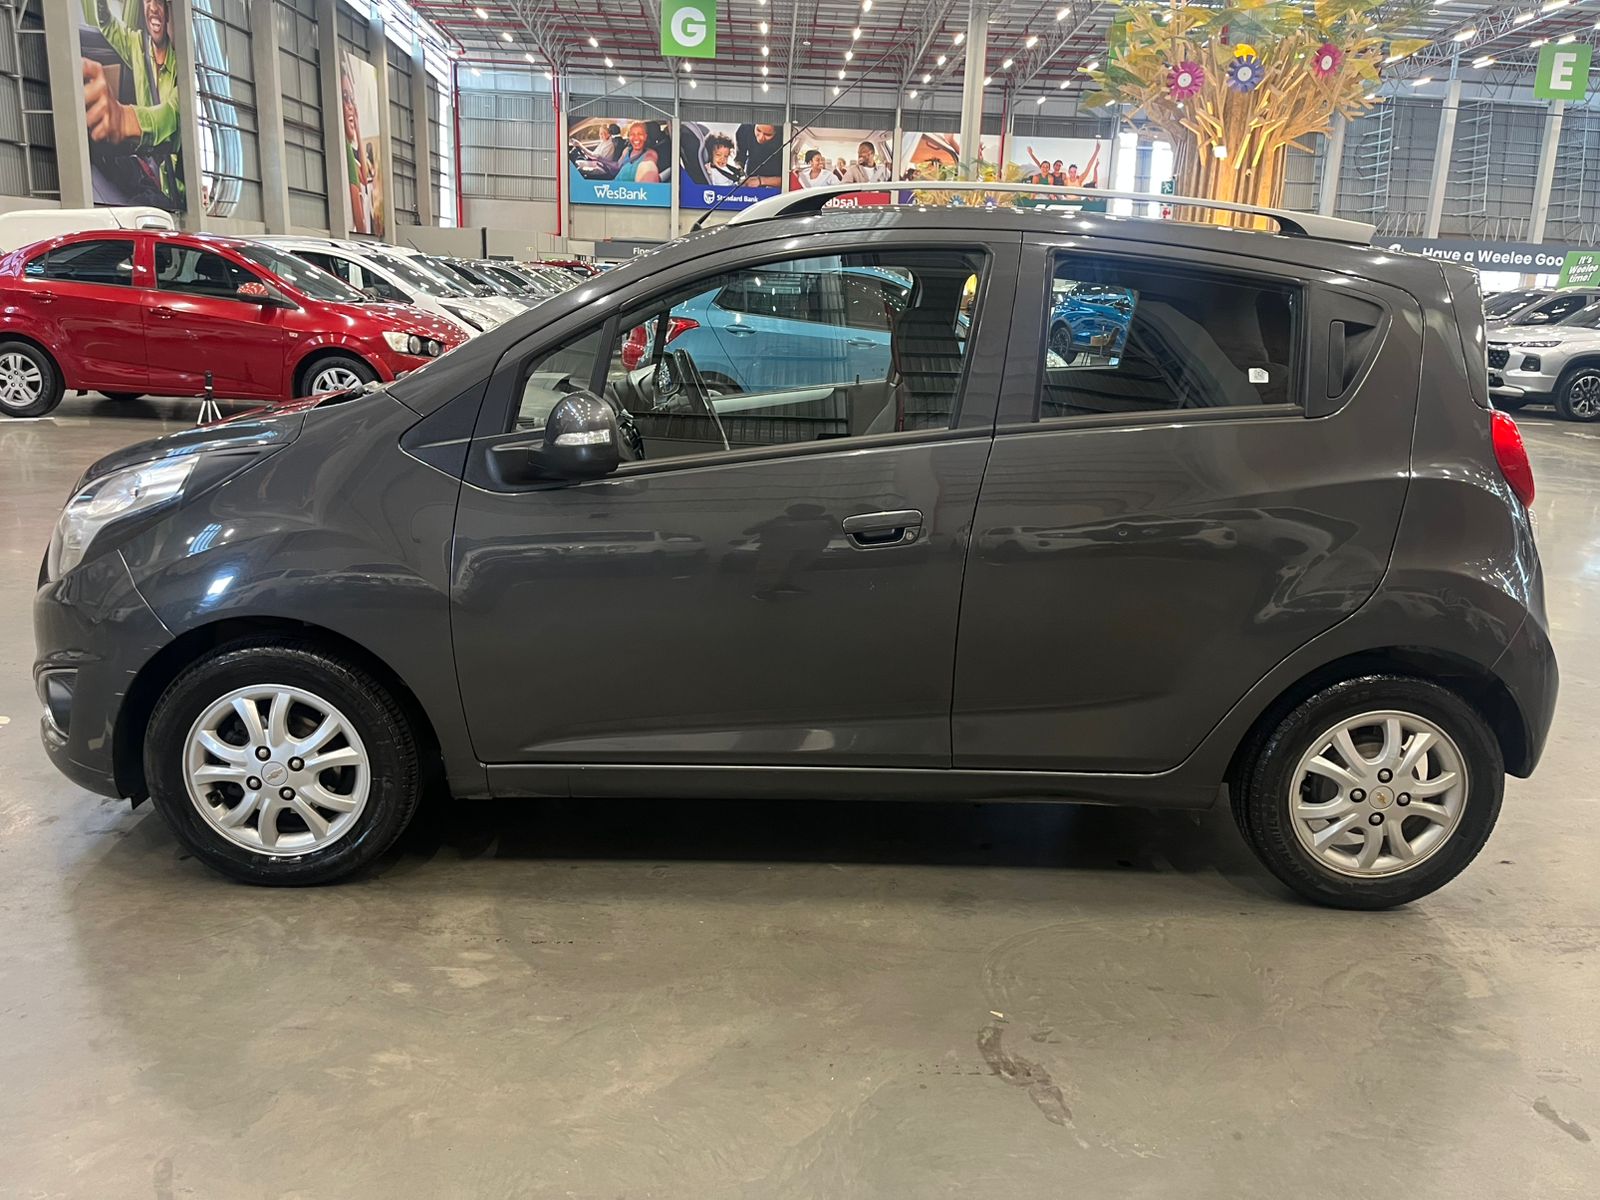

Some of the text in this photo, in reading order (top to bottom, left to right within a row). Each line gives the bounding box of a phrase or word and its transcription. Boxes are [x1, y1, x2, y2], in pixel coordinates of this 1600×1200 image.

[671, 6, 706, 47] G
[1550, 52, 1577, 90] E
[594, 185, 647, 200] WesBank
[1423, 247, 1564, 266] Have a Weelee Goo
[1578, 256, 1593, 264] It's
[1569, 273, 1592, 282] time!
